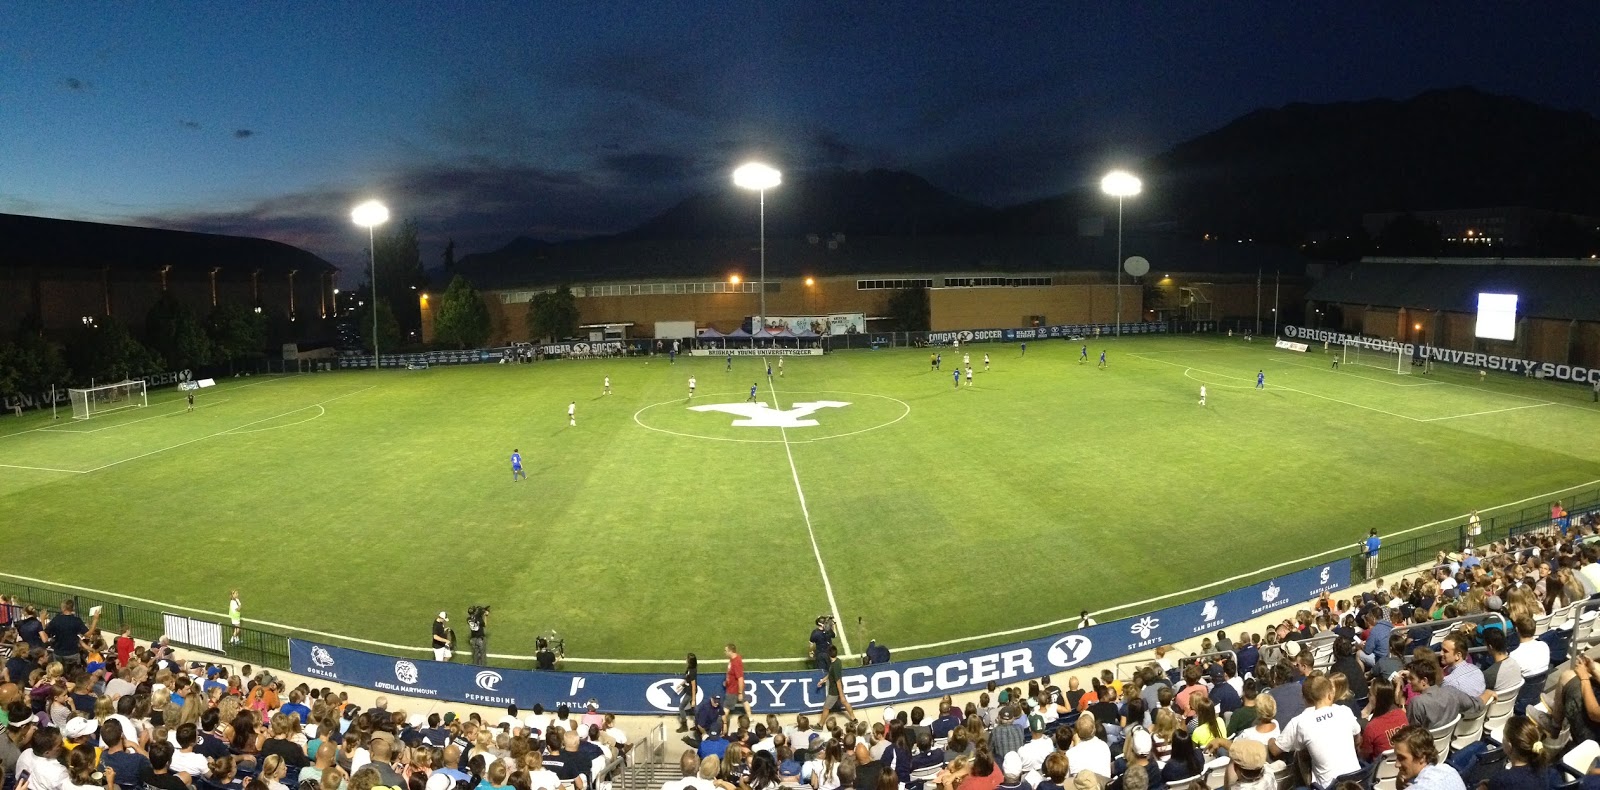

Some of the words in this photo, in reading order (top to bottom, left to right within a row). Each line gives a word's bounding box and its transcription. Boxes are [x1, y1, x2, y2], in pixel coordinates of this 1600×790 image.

[929, 332, 957, 342] COUGAR
[975, 331, 1002, 340] SOCCER
[541, 343, 570, 354] OUGAR
[1298, 327, 1360, 347] BRIGHAM
[1363, 337, 1415, 356] YOUNG
[1419, 345, 1537, 374] UNIVERSITY
[1138, 637, 1162, 648] MARY'S
[307, 667, 337, 679] GONZAGA
[842, 648, 1034, 703] SOCCER
[400, 686, 438, 695] MARYMOUNT
[465, 693, 516, 704] PEPPERDINE
[1315, 712, 1334, 723] BYU
